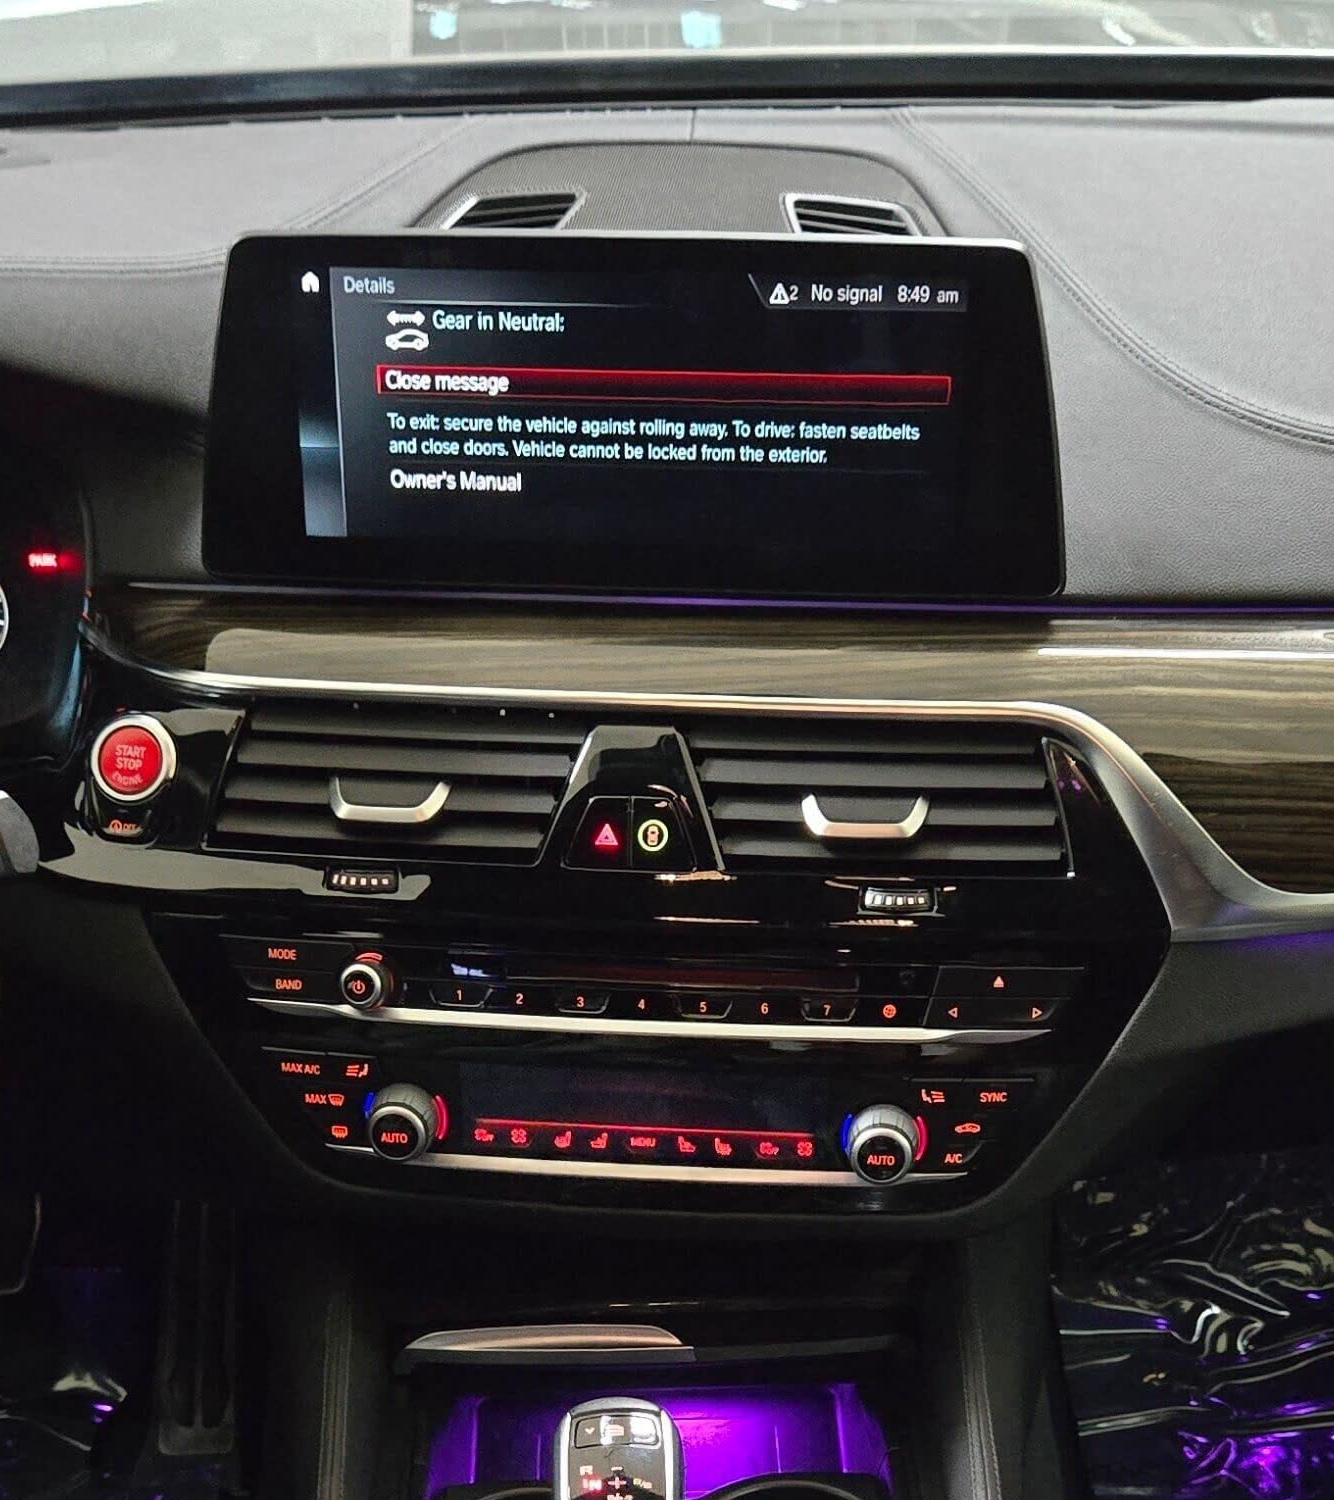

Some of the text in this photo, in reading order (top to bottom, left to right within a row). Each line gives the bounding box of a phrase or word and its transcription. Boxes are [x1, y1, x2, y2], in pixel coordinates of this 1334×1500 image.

[343, 275, 396, 295] Details
[789, 285, 799, 301] 2
[811, 283, 883, 305] No signal
[897, 285, 959, 304] 8:49 am
[432, 309, 565, 333] Gear in Neutral:
[385, 369, 510, 396] Close message
[386, 412, 406, 431] To
[443, 416, 493, 433] secure
[497, 416, 522, 433] the
[525, 416, 577, 435] vehicle
[581, 418, 636, 437] against
[639, 419, 685, 439] rolling
[732, 420, 751, 438] To
[754, 421, 795, 439] drive:
[799, 422, 847, 439] fasten
[850, 423, 921, 441] seatbelts
[389, 438, 828, 464] and close doors. Vehicle cannot be locked from the exterior.
[390, 468, 522, 492] Owner's Manual
[115, 744, 147, 759] START
[116, 757, 143, 770] STOP
[268, 947, 297, 961] MODE
[275, 978, 302, 990] BAND
[456, 988, 463, 1001] 1
[515, 992, 524, 1005] 2
[576, 995, 585, 1008] 3
[638, 998, 646, 1010] 4
[699, 1001, 707, 1014] 5
[760, 1003, 769, 1015] 6
[823, 1004, 831, 1017] 7
[281, 1062, 321, 1076] MAX A/C
[305, 1093, 327, 1106] MAX
[979, 1091, 1008, 1104] SYNC
[381, 1131, 408, 1145] AUTO
[866, 1153, 896, 1168] AUTO
[944, 1154, 963, 1166] A/C
